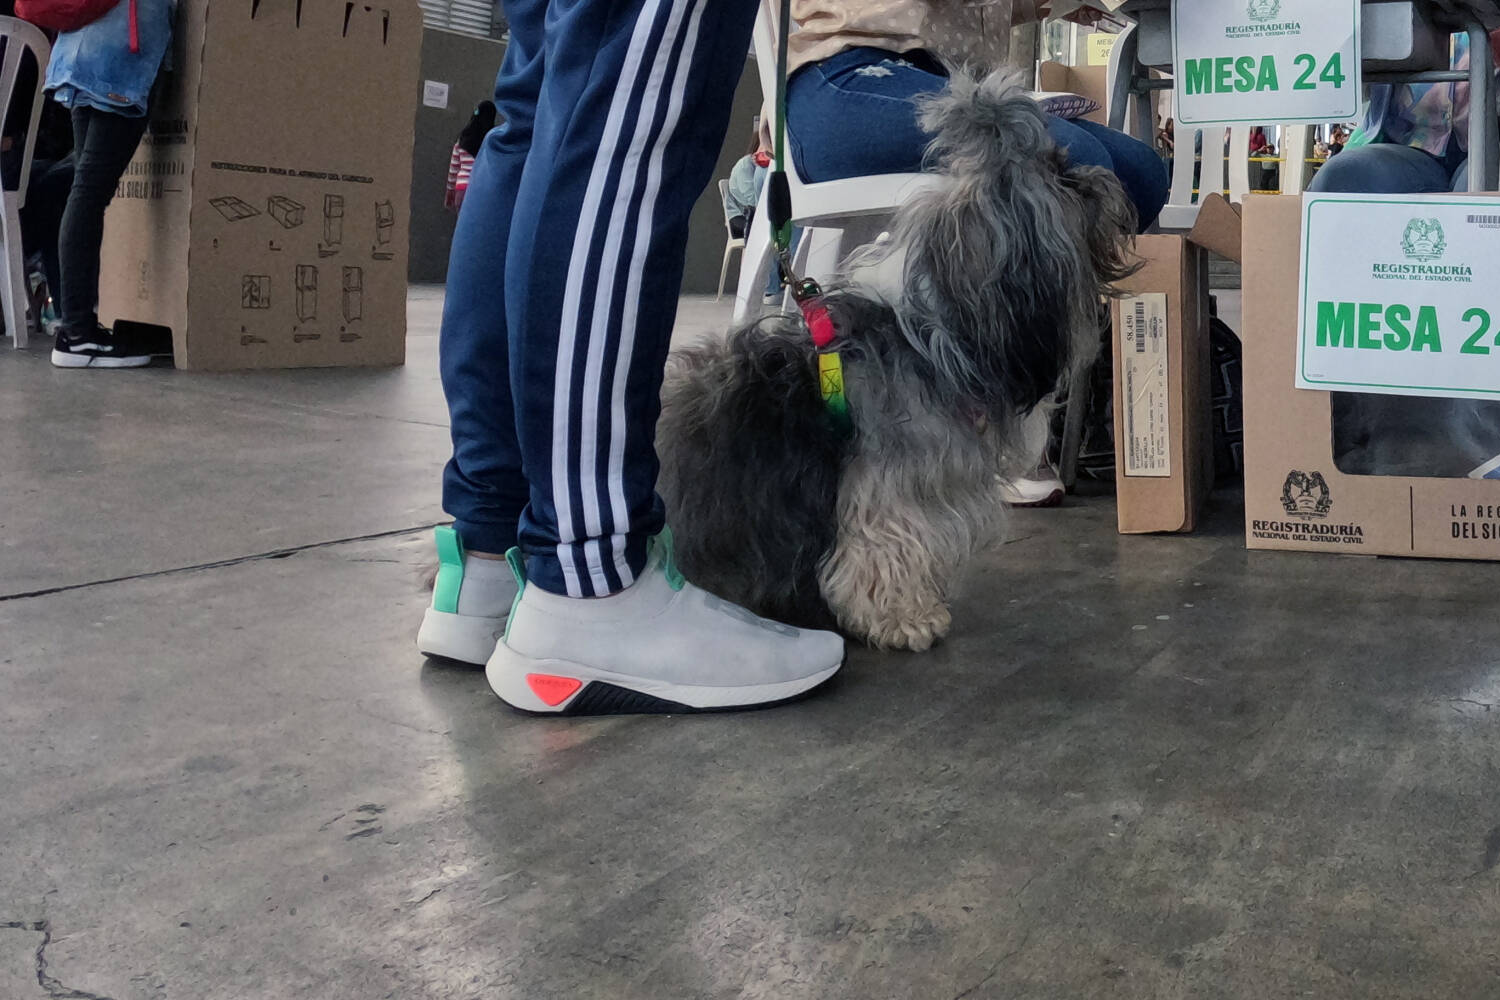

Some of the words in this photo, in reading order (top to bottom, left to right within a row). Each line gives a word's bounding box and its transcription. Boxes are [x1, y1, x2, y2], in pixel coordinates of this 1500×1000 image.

[1225, 21, 1301, 33] REGISTRADURÍA
[1185, 55, 1279, 96] MESA
[1293, 52, 1345, 90] 24
[1373, 262, 1472, 276] REGISTRADURÍA
[1316, 301, 1442, 352] MESA
[1451, 504, 1467, 517] LA
[1252, 520, 1363, 537] REGISTRADURÍA
[1451, 521, 1478, 539] DEL
[1252, 531, 1290, 540] NACIONAL
[1310, 535, 1341, 543] ESTADO
[1342, 536, 1363, 545] CIVIL
